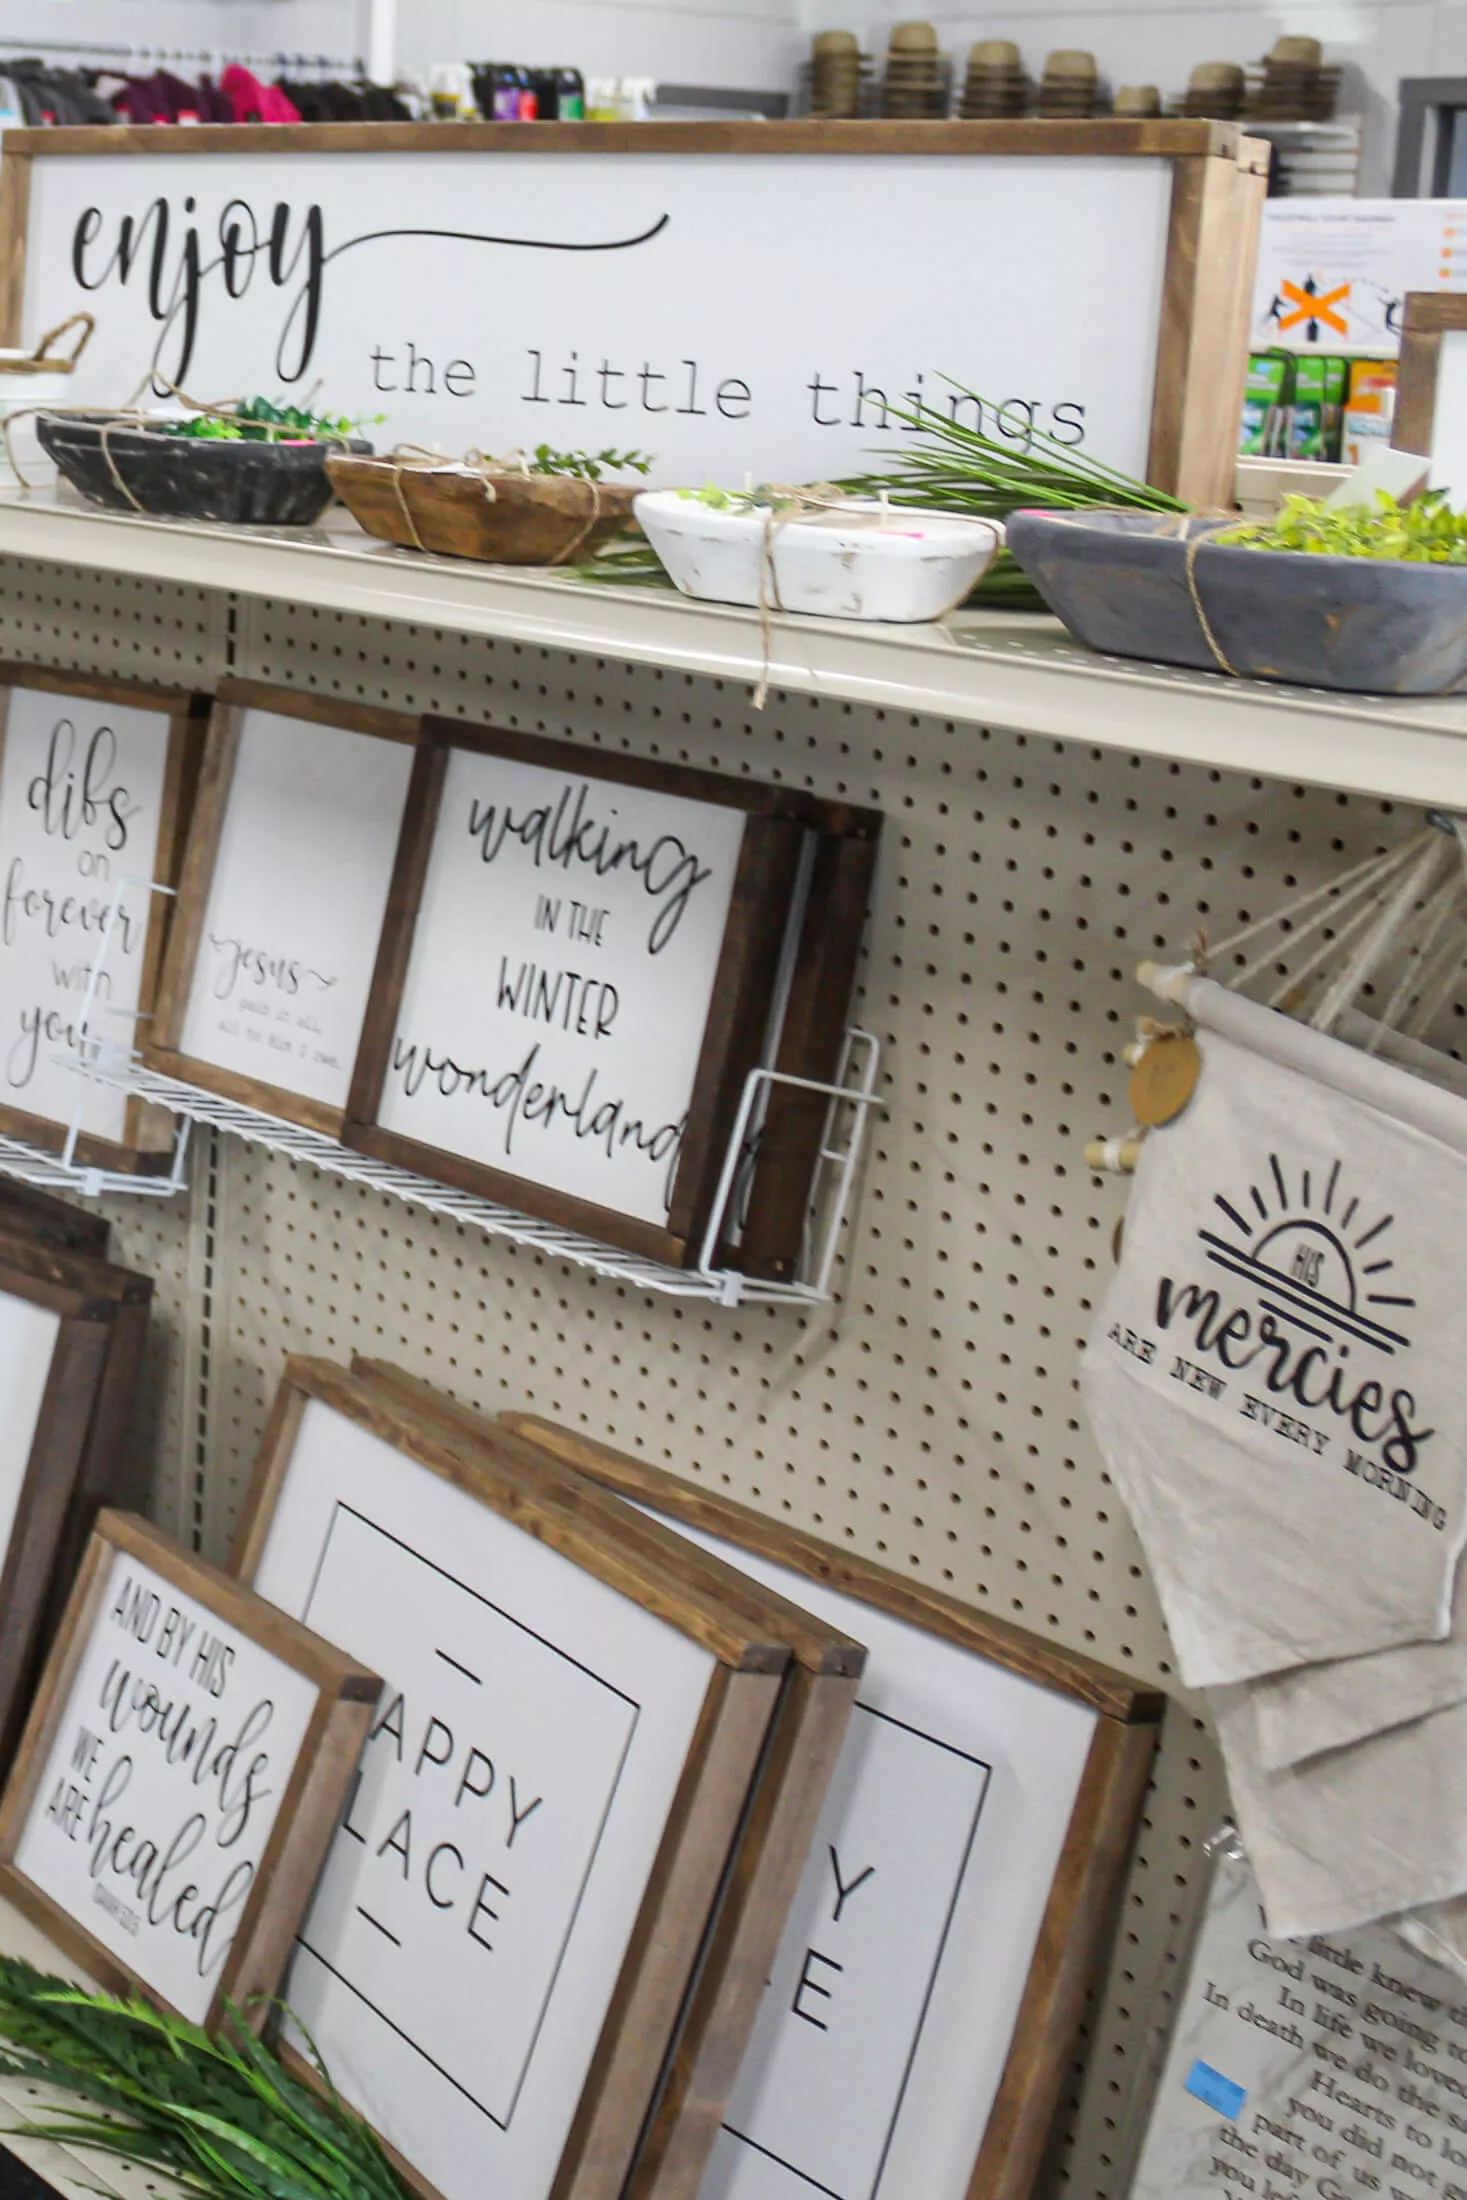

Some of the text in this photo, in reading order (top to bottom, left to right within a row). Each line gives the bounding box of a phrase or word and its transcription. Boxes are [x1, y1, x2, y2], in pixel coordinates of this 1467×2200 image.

[369, 342, 1087, 454] the little things
[27, 718, 142, 850] dibs
[2, 856, 140, 954] forever
[78, 850, 110, 883] on
[469, 784, 713, 955] walking
[533, 893, 611, 948] IN THE
[51, 957, 112, 1000] with
[496, 954, 620, 1039] WINTER
[392, 1036, 690, 1213] wonderland
[1291, 1242, 1325, 1289] HIS
[1155, 1276, 1435, 1474] mercies
[1106, 1322, 1448, 1532] ARE NEW EVERY MORNING
[109, 1576, 238, 1700] AND BY HIS
[70, 1725, 105, 1783] WE
[99, 1659, 275, 1849] wounds
[369, 1693, 543, 1848] APPY
[45, 1777, 91, 1842] ARE
[89, 1754, 254, 1978] healed
[343, 1770, 510, 1952] LACE
[1248, 1938, 1304, 1981] God
[1311, 1974, 1358, 2008] was
[1360, 2002, 1440, 2055] going
[1277, 1985, 1305, 2016] In
[1313, 2002, 1353, 2040] life
[1360, 2033, 1398, 2062] we
[1202, 1981, 1230, 2011] In
[1237, 2001, 1304, 2050] death
[1312, 2042, 1348, 2071] we
[1355, 2061, 1389, 2091] do
[1398, 2084, 1440, 2118] the
[1220, 2124, 1309, 2188] the day
[1252, 2114, 1306, 2151] part
[1312, 2145, 1346, 2170] of
[1352, 2166, 1381, 2191] us
[1286, 2097, 1334, 2132] you
[1340, 2123, 1384, 2159] did
[1391, 2153, 1438, 2188] not
[1310, 2070, 1397, 2130] Hearts
[1405, 2125, 1433, 2149] to
[1209, 2155, 1255, 2192] you
